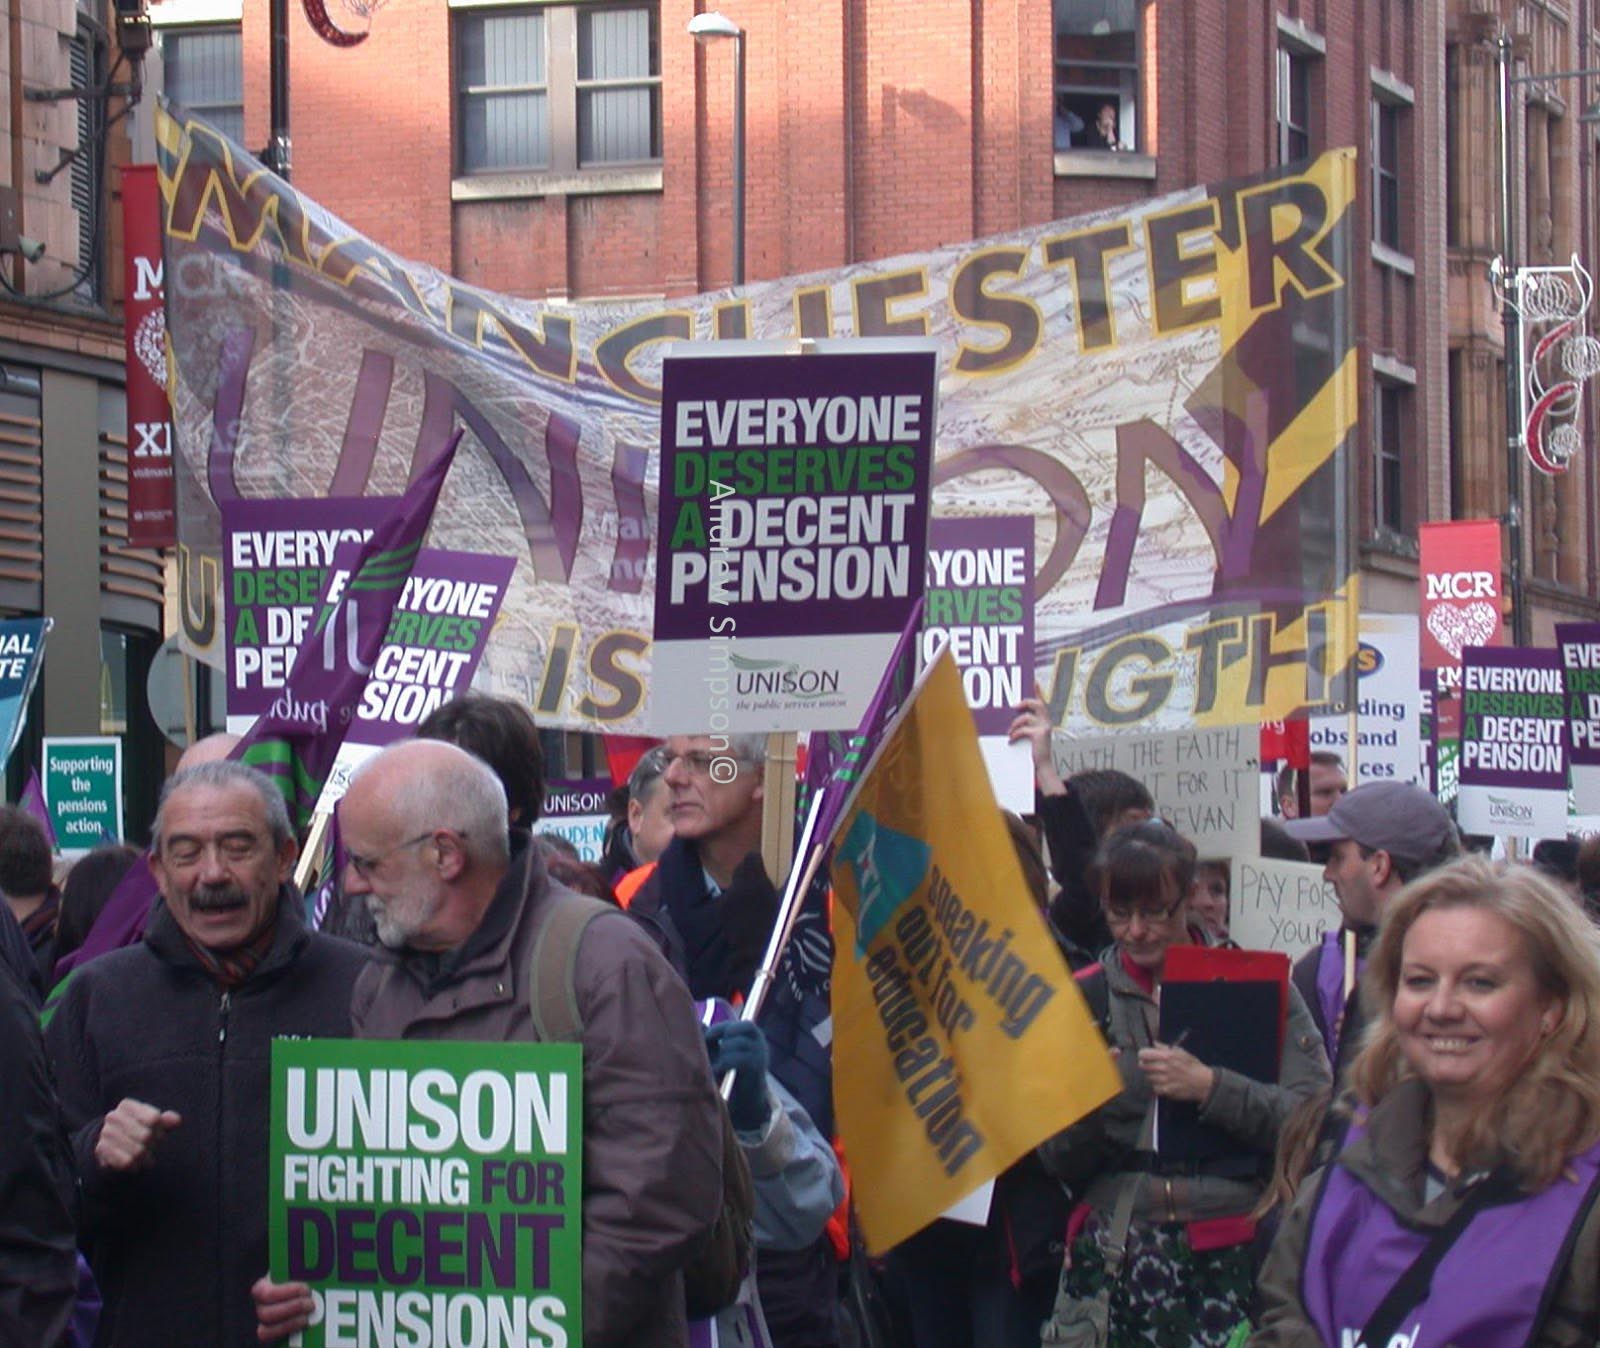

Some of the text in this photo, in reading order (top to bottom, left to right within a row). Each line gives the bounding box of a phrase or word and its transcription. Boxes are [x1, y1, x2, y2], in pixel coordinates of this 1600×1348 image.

[675, 395, 921, 447] EVERYONE
[674, 445, 916, 497] DESERVES
[670, 501, 707, 549] A
[720, 494, 915, 547] DECENT
[670, 545, 909, 605] PENSION
[1426, 571, 1497, 600] MCR
[234, 609, 259, 644] A
[534, 621, 653, 723] IS
[736, 670, 840, 694] UNISON
[1465, 690, 1564, 717] DESERVES
[1310, 727, 1348, 745] obs
[1464, 716, 1564, 744] A DECENT
[50, 756, 113, 775] Supporting
[1053, 731, 1241, 776] WITH THE FAITH
[1463, 741, 1563, 773] PENSION
[71, 776, 91, 792] the
[1177, 770, 1208, 797] FOR
[57, 799, 107, 816] pensions
[543, 792, 606, 813] UNISON
[1488, 805, 1533, 819] UNISON
[1240, 864, 1287, 914] PAY
[865, 944, 985, 1179] education
[286, 1067, 568, 1154] UNISON
[284, 1154, 565, 1205] FIGHTING FOR
[287, 1207, 565, 1290] DECENT
